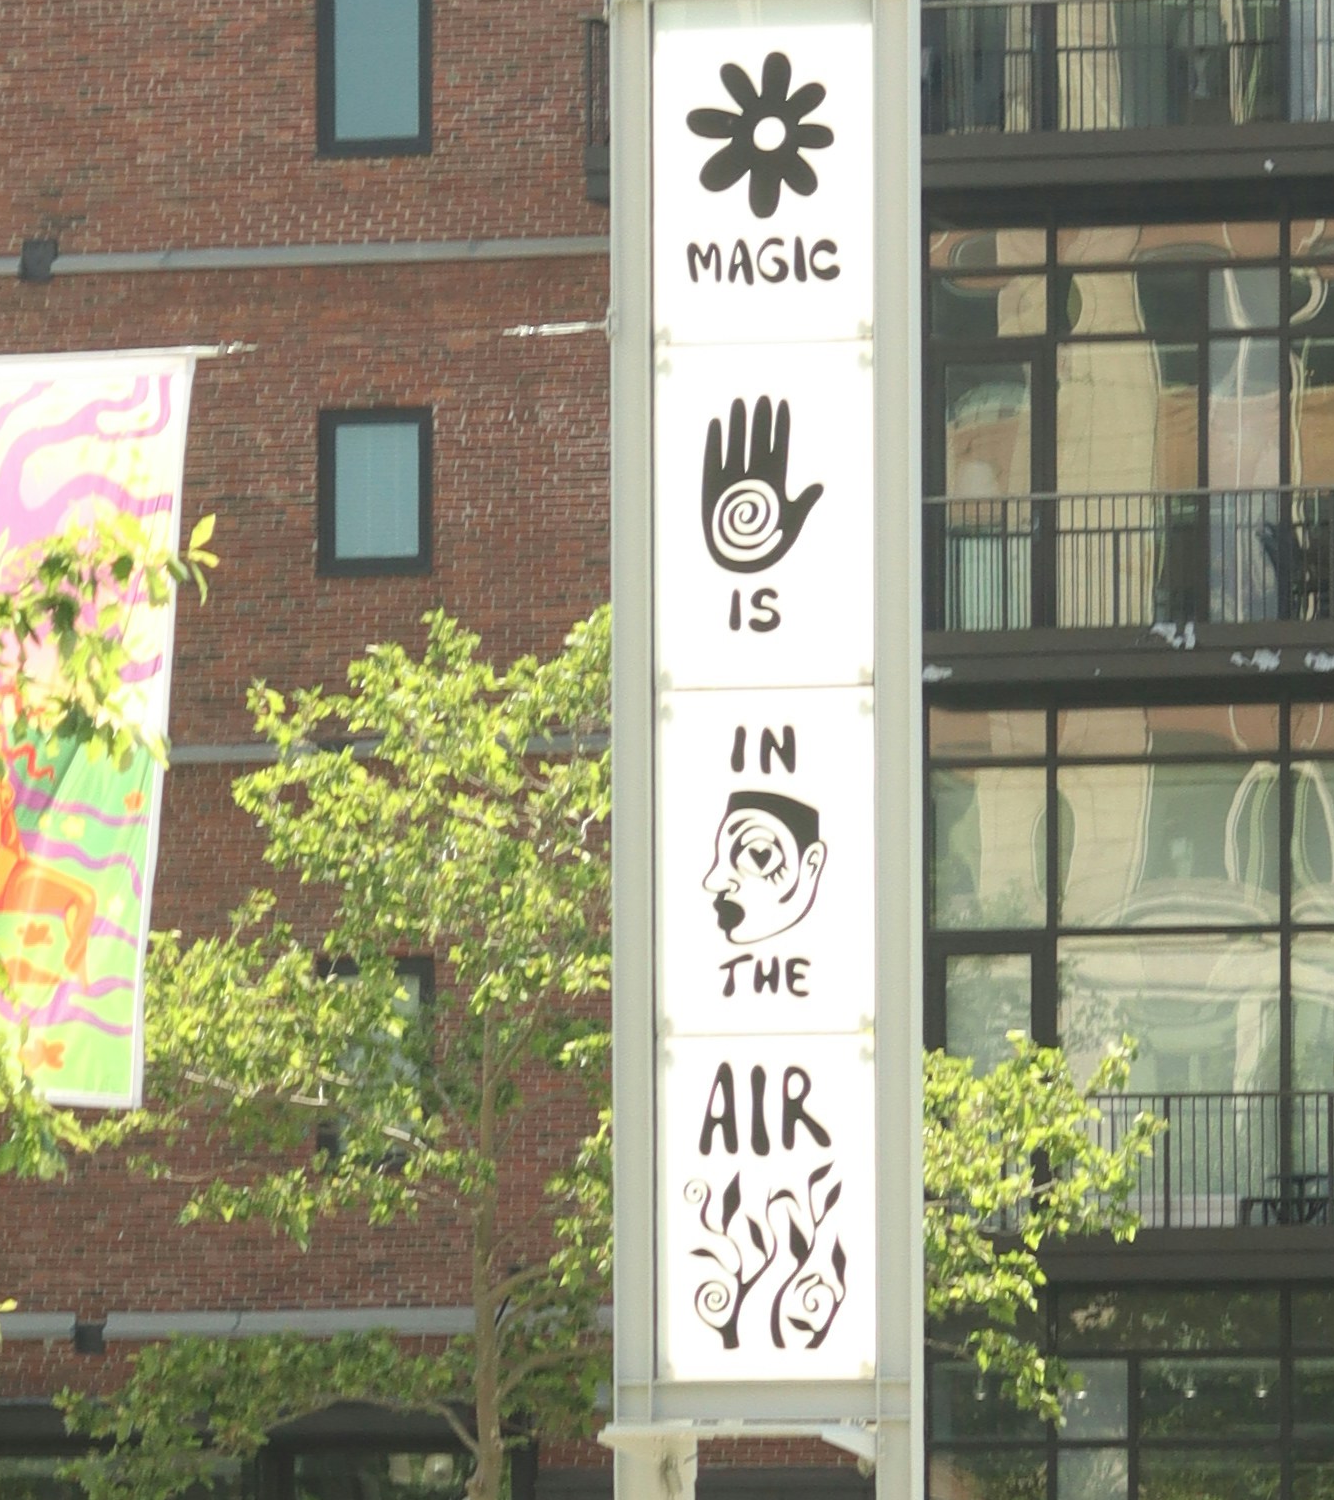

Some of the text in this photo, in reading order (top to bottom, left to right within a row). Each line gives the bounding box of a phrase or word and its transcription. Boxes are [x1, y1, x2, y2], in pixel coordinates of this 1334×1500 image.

[687, 235, 840, 285] MAGIC
[729, 587, 781, 632] IS
[730, 725, 796, 773] IN
[719, 954, 811, 997] THE
[699, 1062, 832, 1156] AIR
